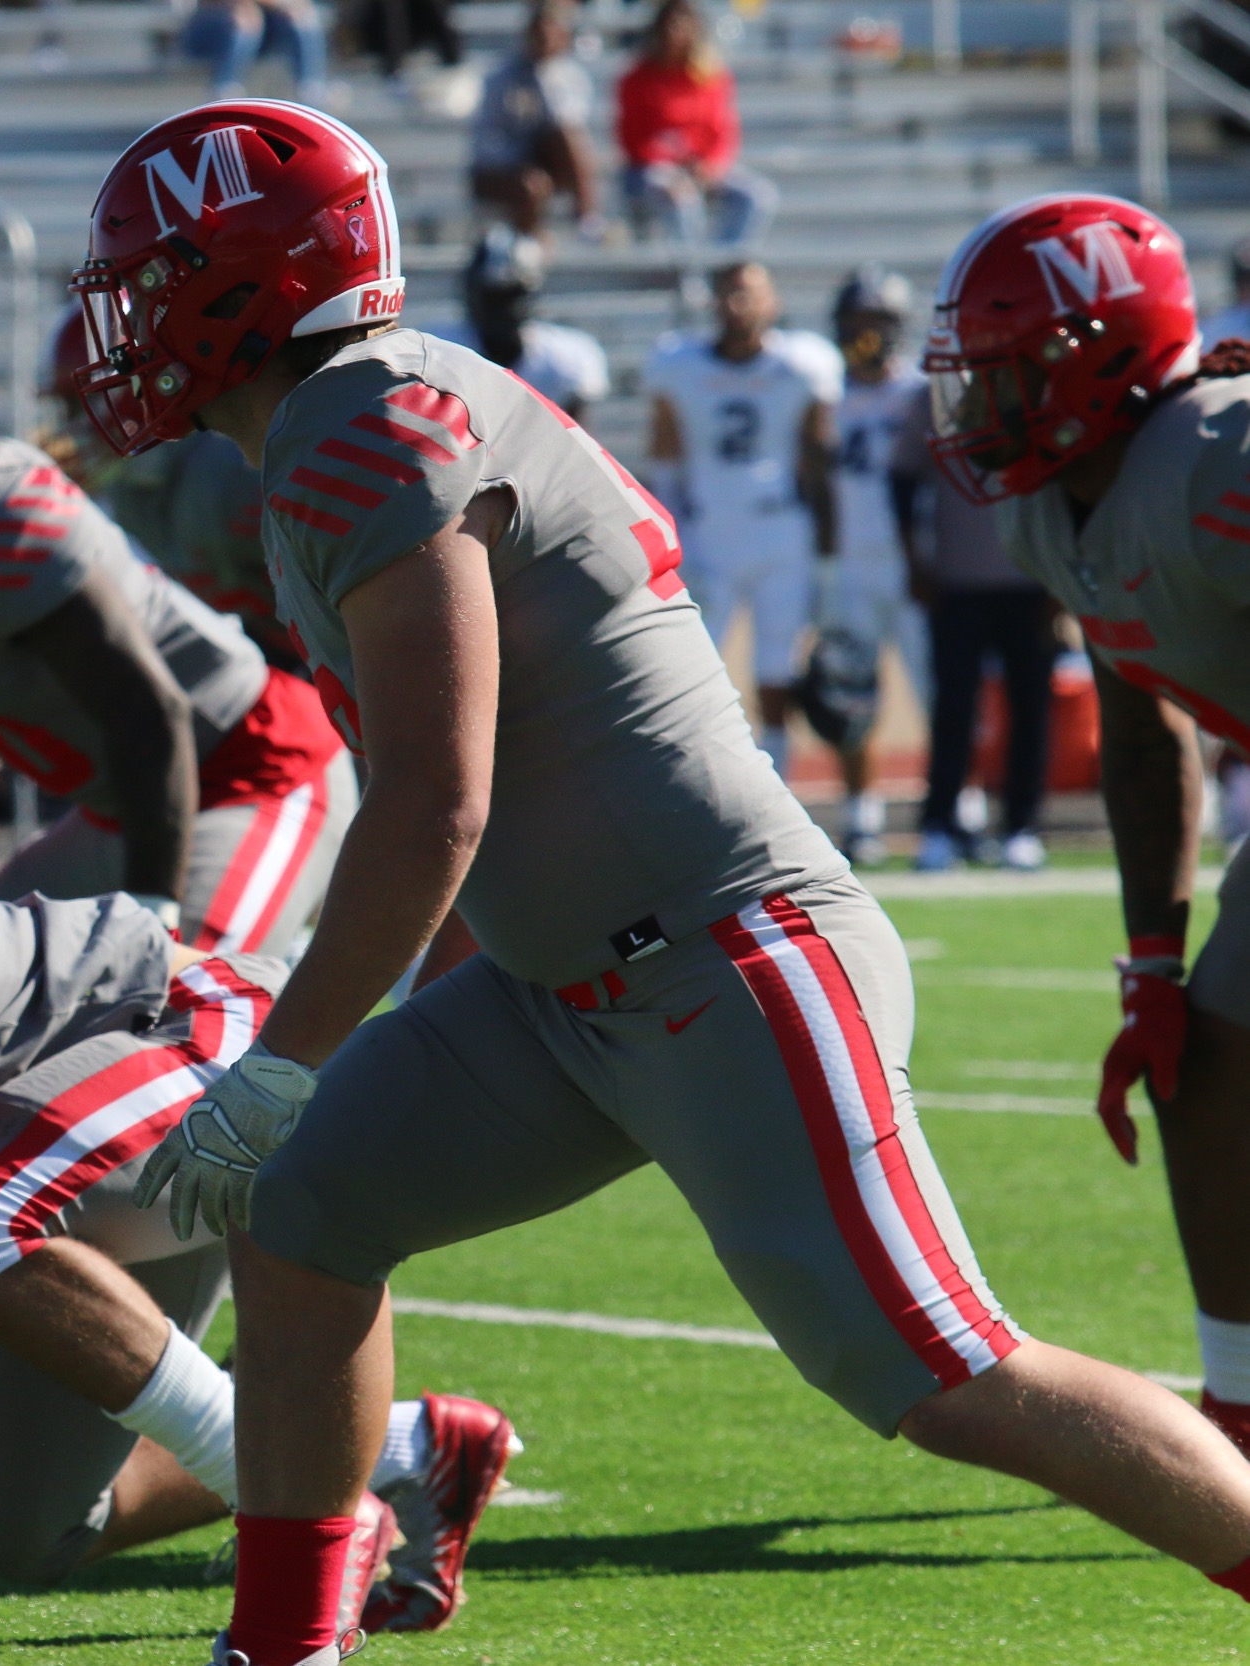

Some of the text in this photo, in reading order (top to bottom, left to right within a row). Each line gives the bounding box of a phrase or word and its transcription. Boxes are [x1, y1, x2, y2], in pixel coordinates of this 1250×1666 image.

[138, 125, 265, 241] M
[1024, 219, 1146, 318] M
[717, 400, 759, 461] 2
[629, 932, 645, 946] L
